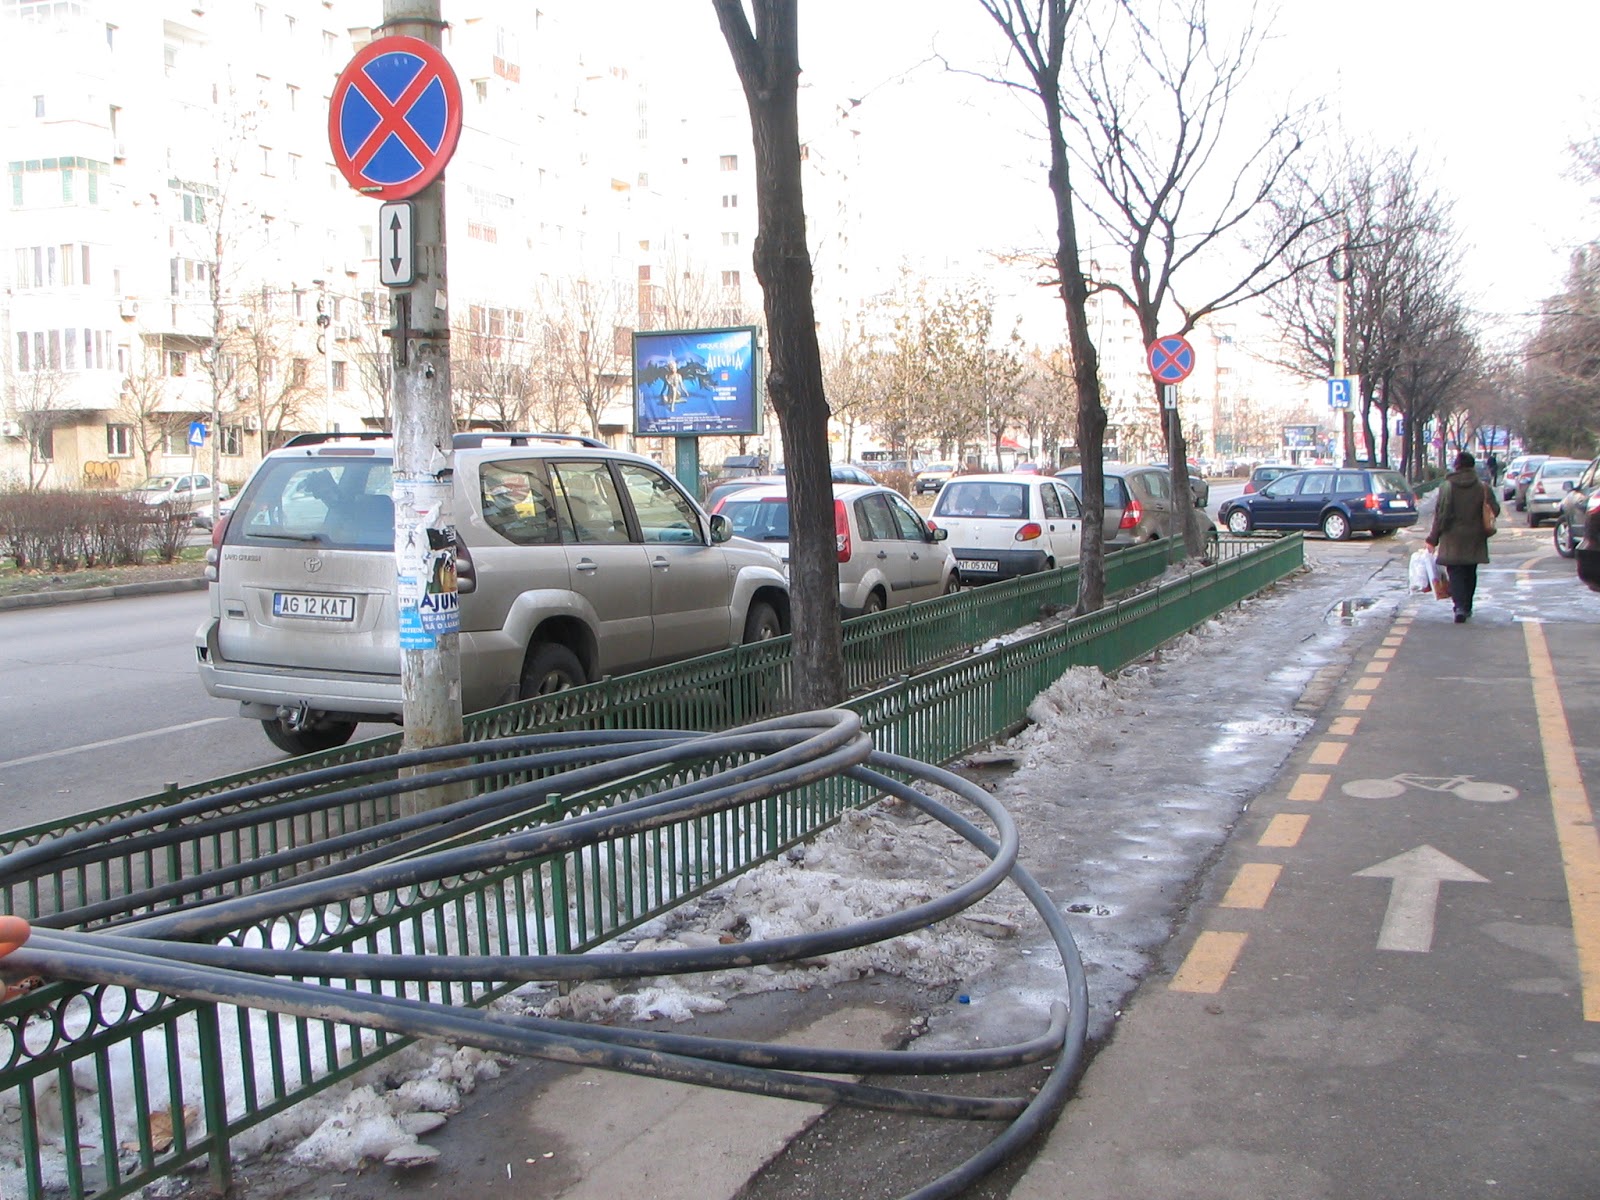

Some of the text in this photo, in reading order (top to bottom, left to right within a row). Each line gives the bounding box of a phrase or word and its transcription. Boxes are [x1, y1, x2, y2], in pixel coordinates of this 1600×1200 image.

[1332, 381, 1344, 405] P
[970, 561, 981, 570] 05
[282, 596, 347, 616] AG 12 KAT
